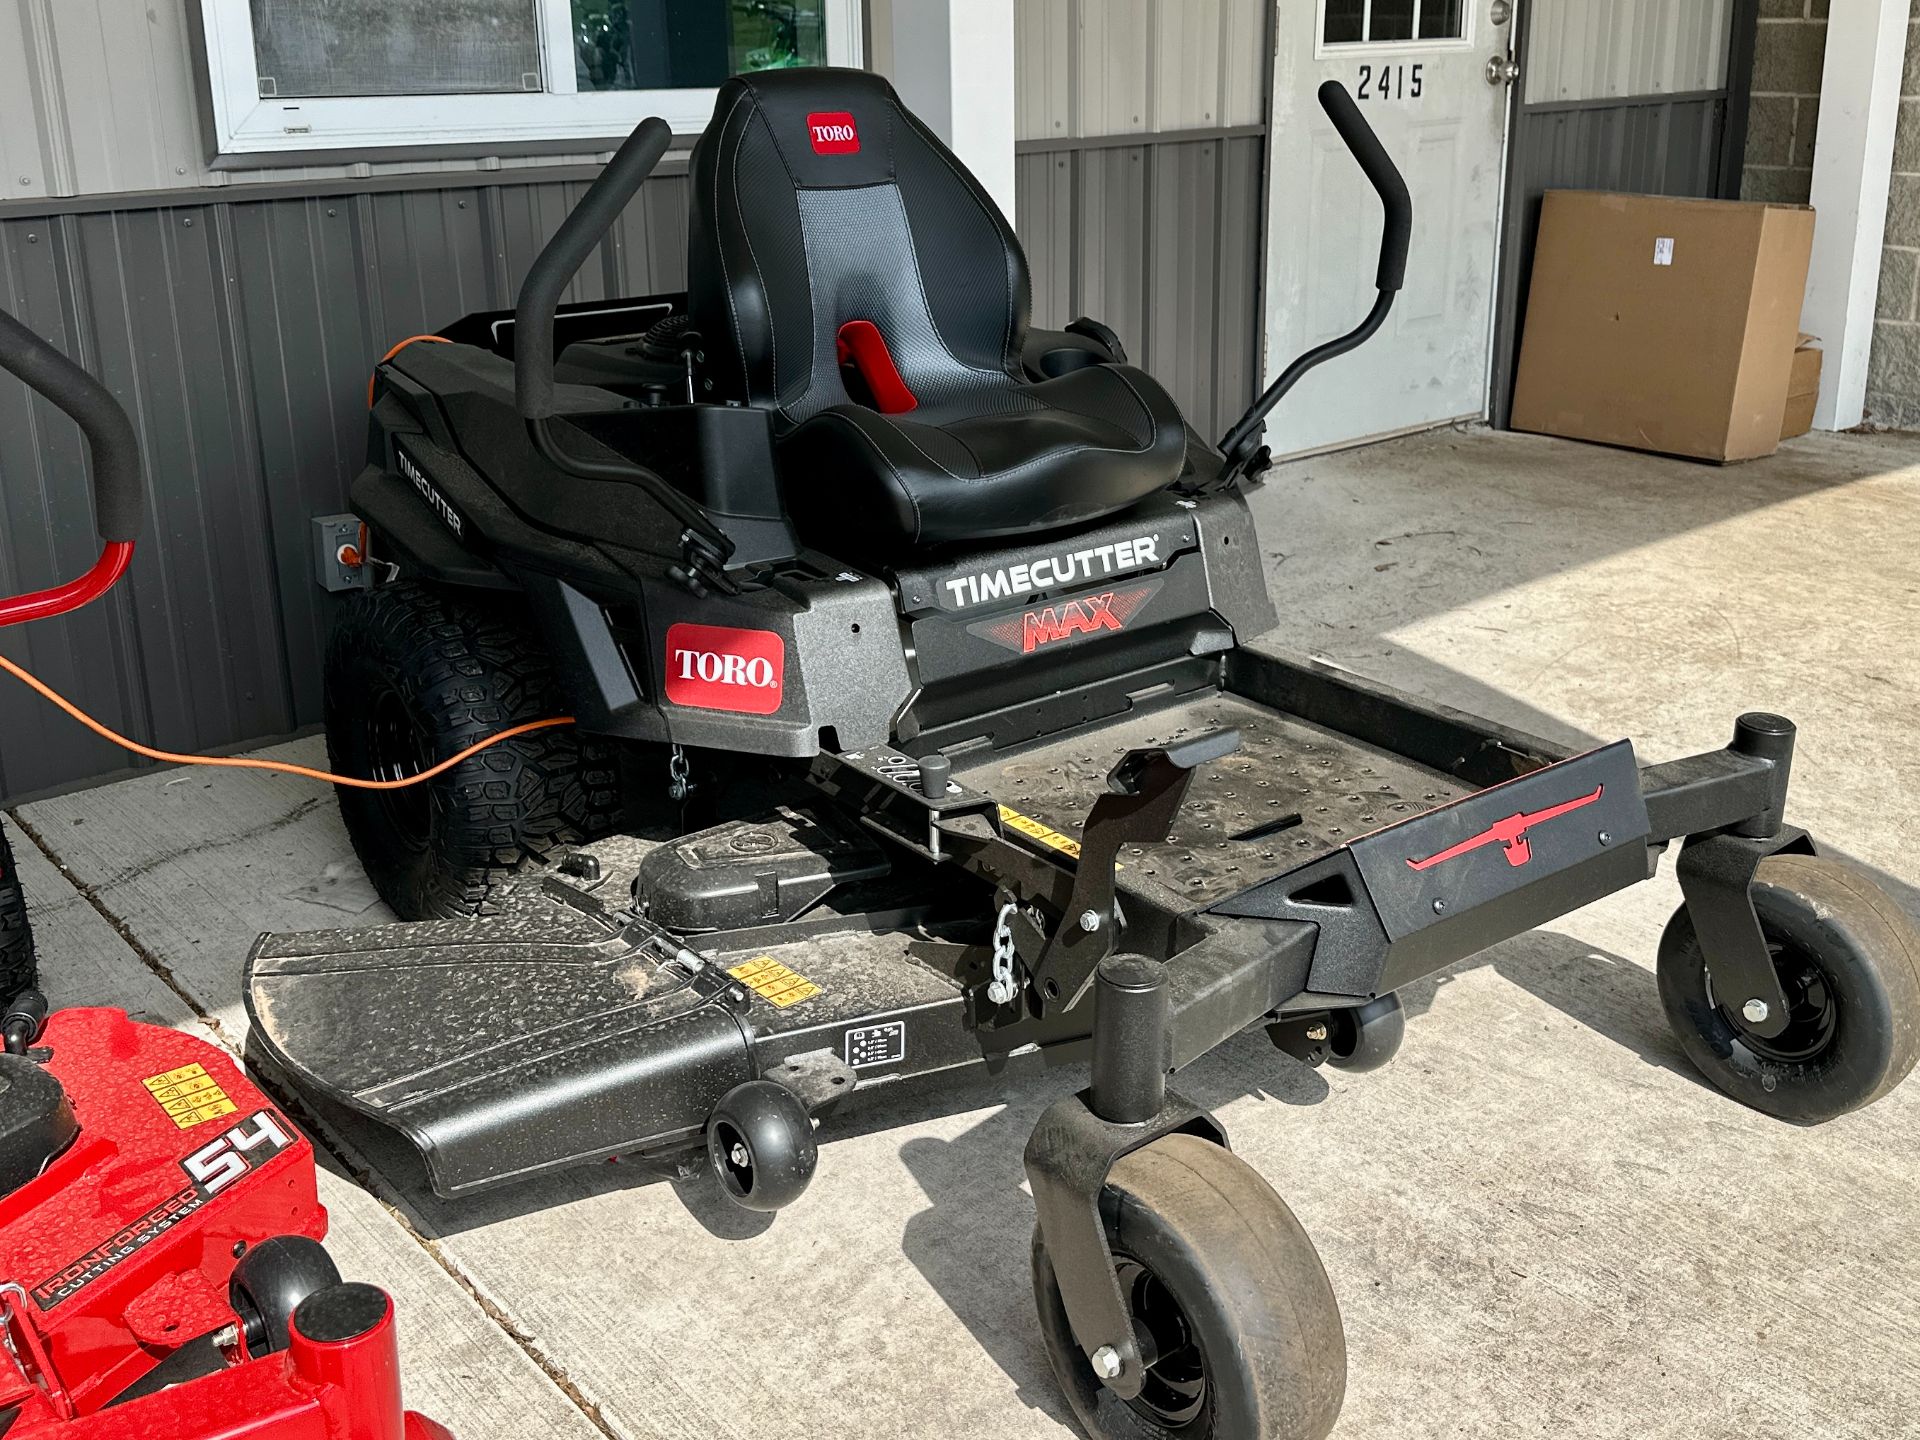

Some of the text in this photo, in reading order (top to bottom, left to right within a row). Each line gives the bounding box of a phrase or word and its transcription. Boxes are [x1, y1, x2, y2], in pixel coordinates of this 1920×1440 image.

[1358, 64, 1423, 100] 2415
[812, 124, 854, 142] TORO
[398, 450, 461, 536] TIMECUTTER
[1023, 592, 1123, 653] MAX
[183, 1111, 292, 1194] 54
[36, 1189, 198, 1299] IRONFORGED
[57, 1200, 204, 1298] CUTTING SYSTEM
